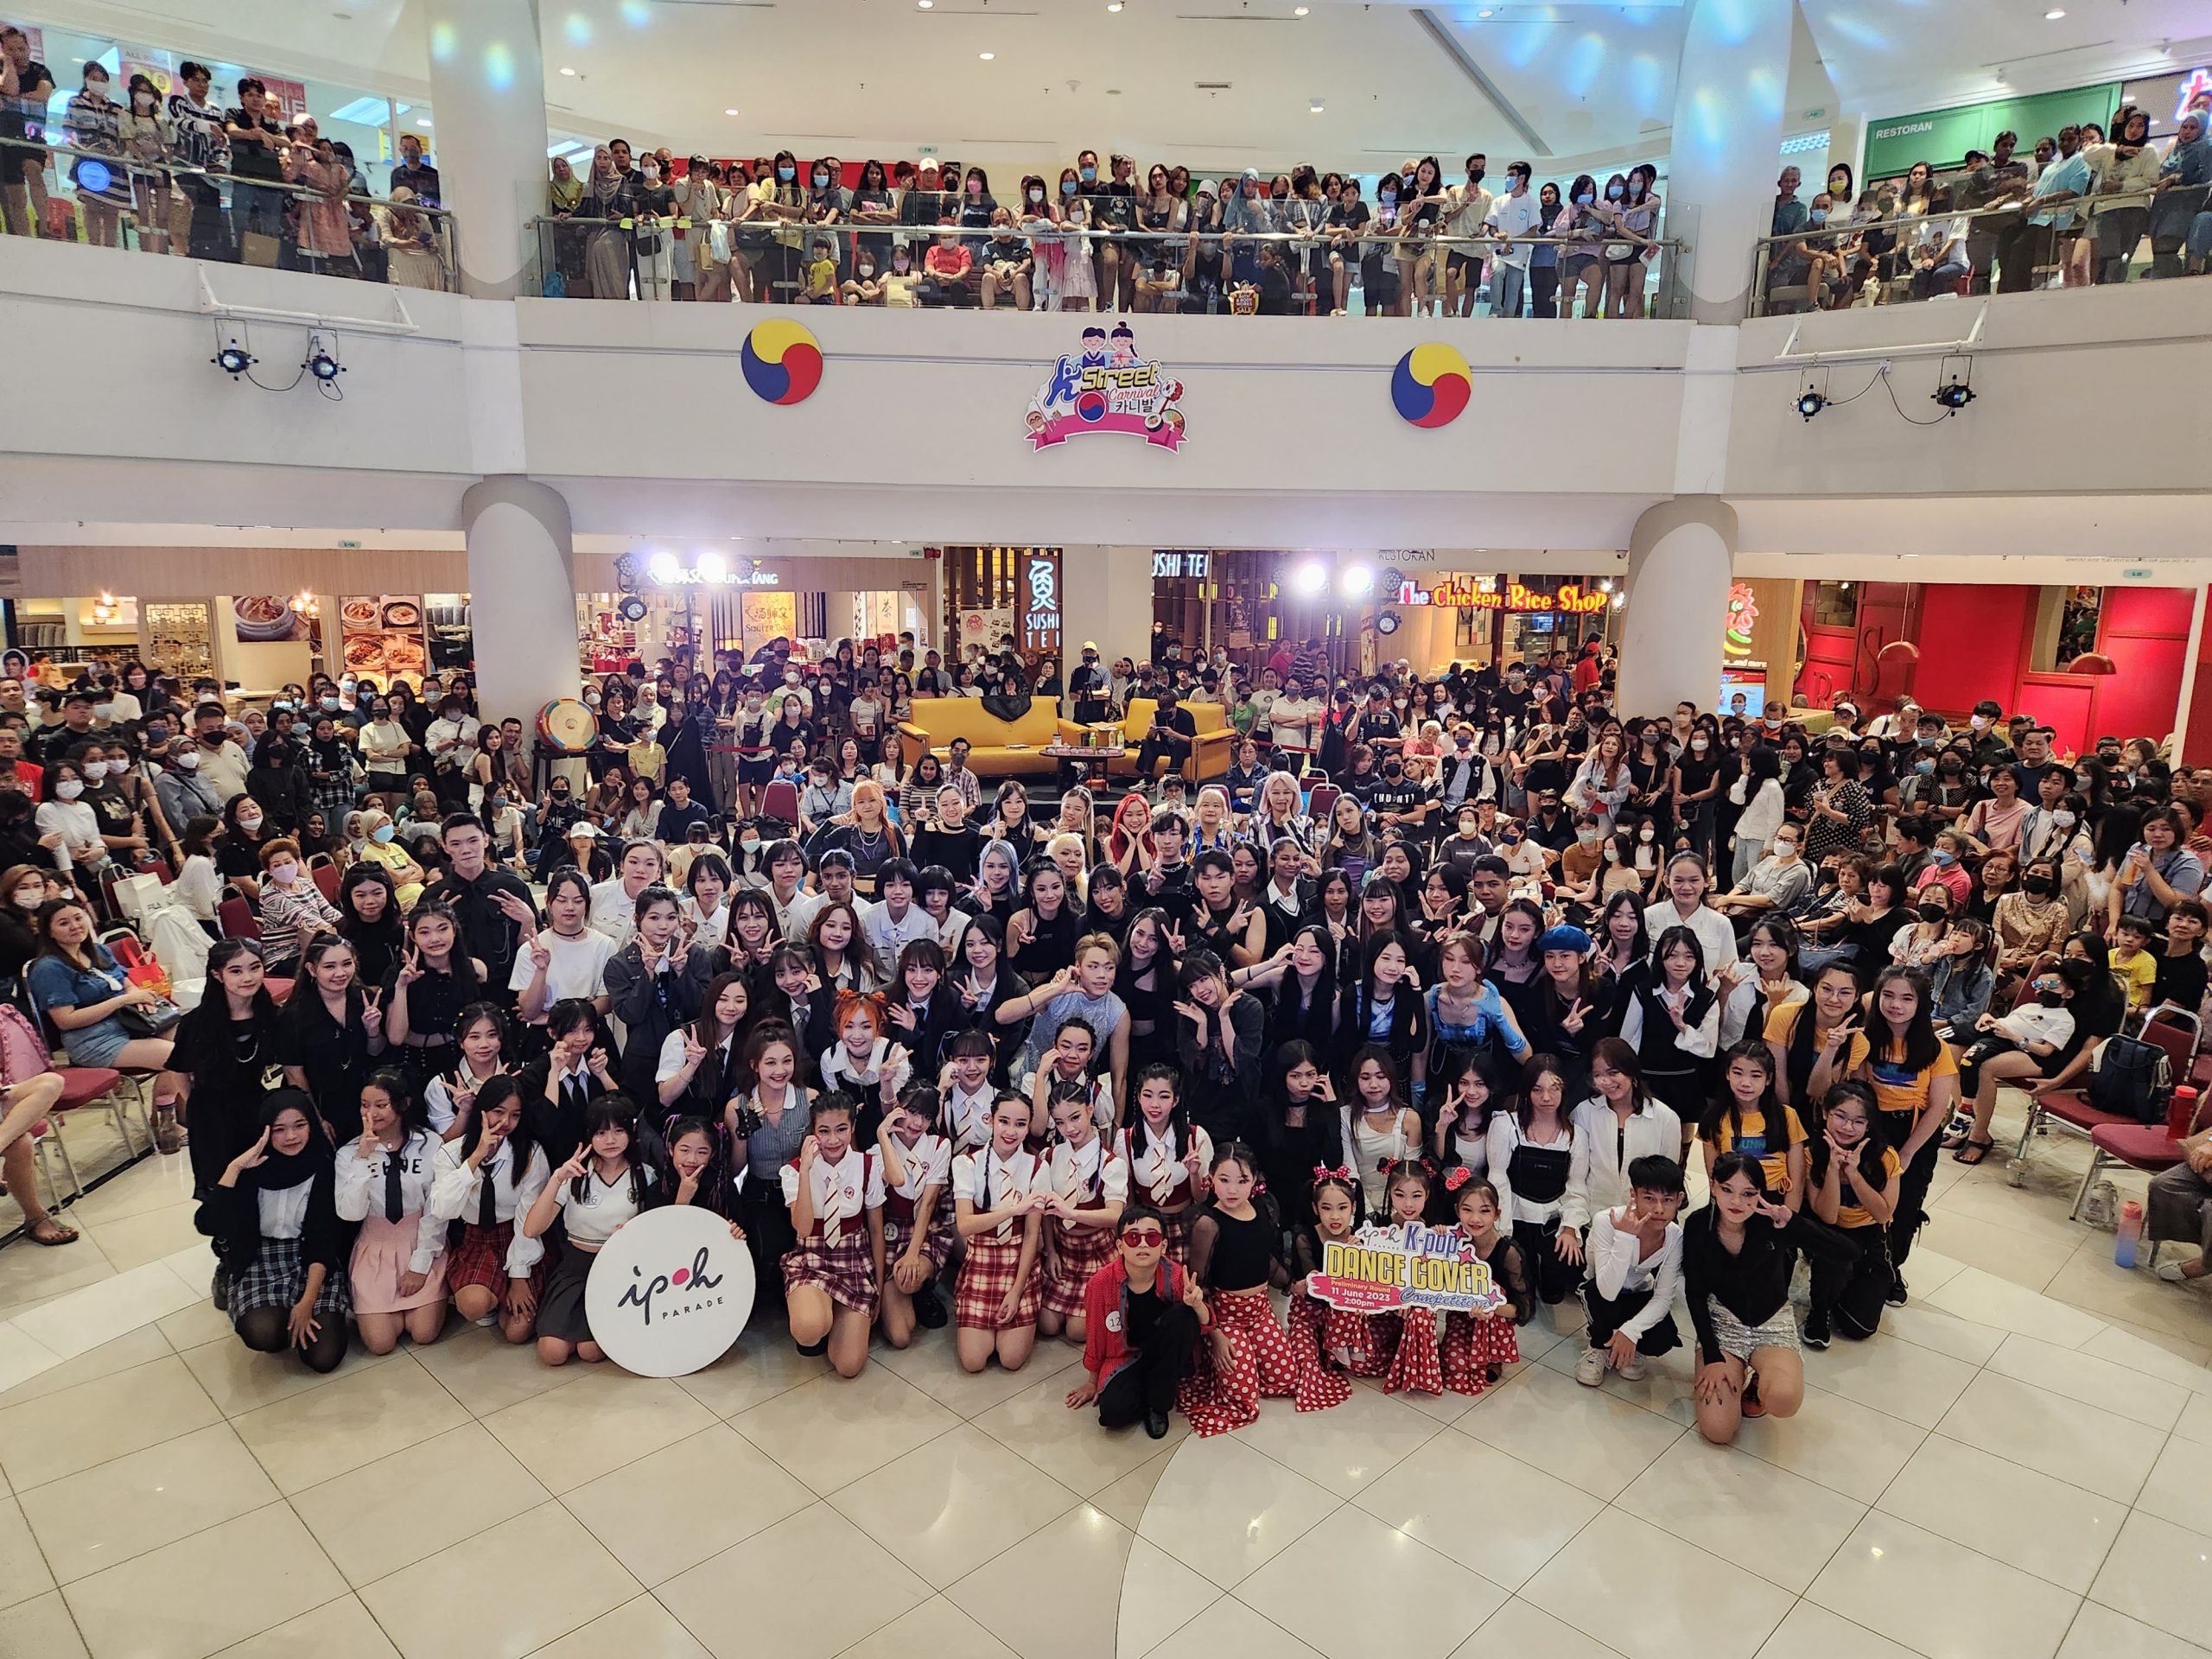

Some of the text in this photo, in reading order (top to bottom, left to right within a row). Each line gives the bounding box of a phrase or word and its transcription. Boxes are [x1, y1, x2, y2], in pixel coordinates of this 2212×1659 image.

[1876, 120, 1933, 140] RESTORAN
[1081, 361, 1160, 391] Street
[1109, 384, 1160, 402] Carnival
[1115, 399, 1154, 414] 카니발
[1188, 553, 1209, 577] TEI
[1397, 580, 1608, 613] The Chicken Rice Shop
[1025, 613, 1060, 630] SUSHI
[1026, 631, 1060, 649] TEI
[1357, 1223, 1459, 1259] ipoh K-pop
[1325, 1243, 1490, 1295] DANCE COVER
[617, 1247, 723, 1325] ipoh
[1331, 1280, 1391, 1294] Preliminary Round
[1331, 1287, 1390, 1302] 11 June 2023
[1344, 1297, 1376, 1307] 2:00pm
[1399, 1287, 1491, 1308] Competition
[662, 1296, 724, 1320] PARADE
